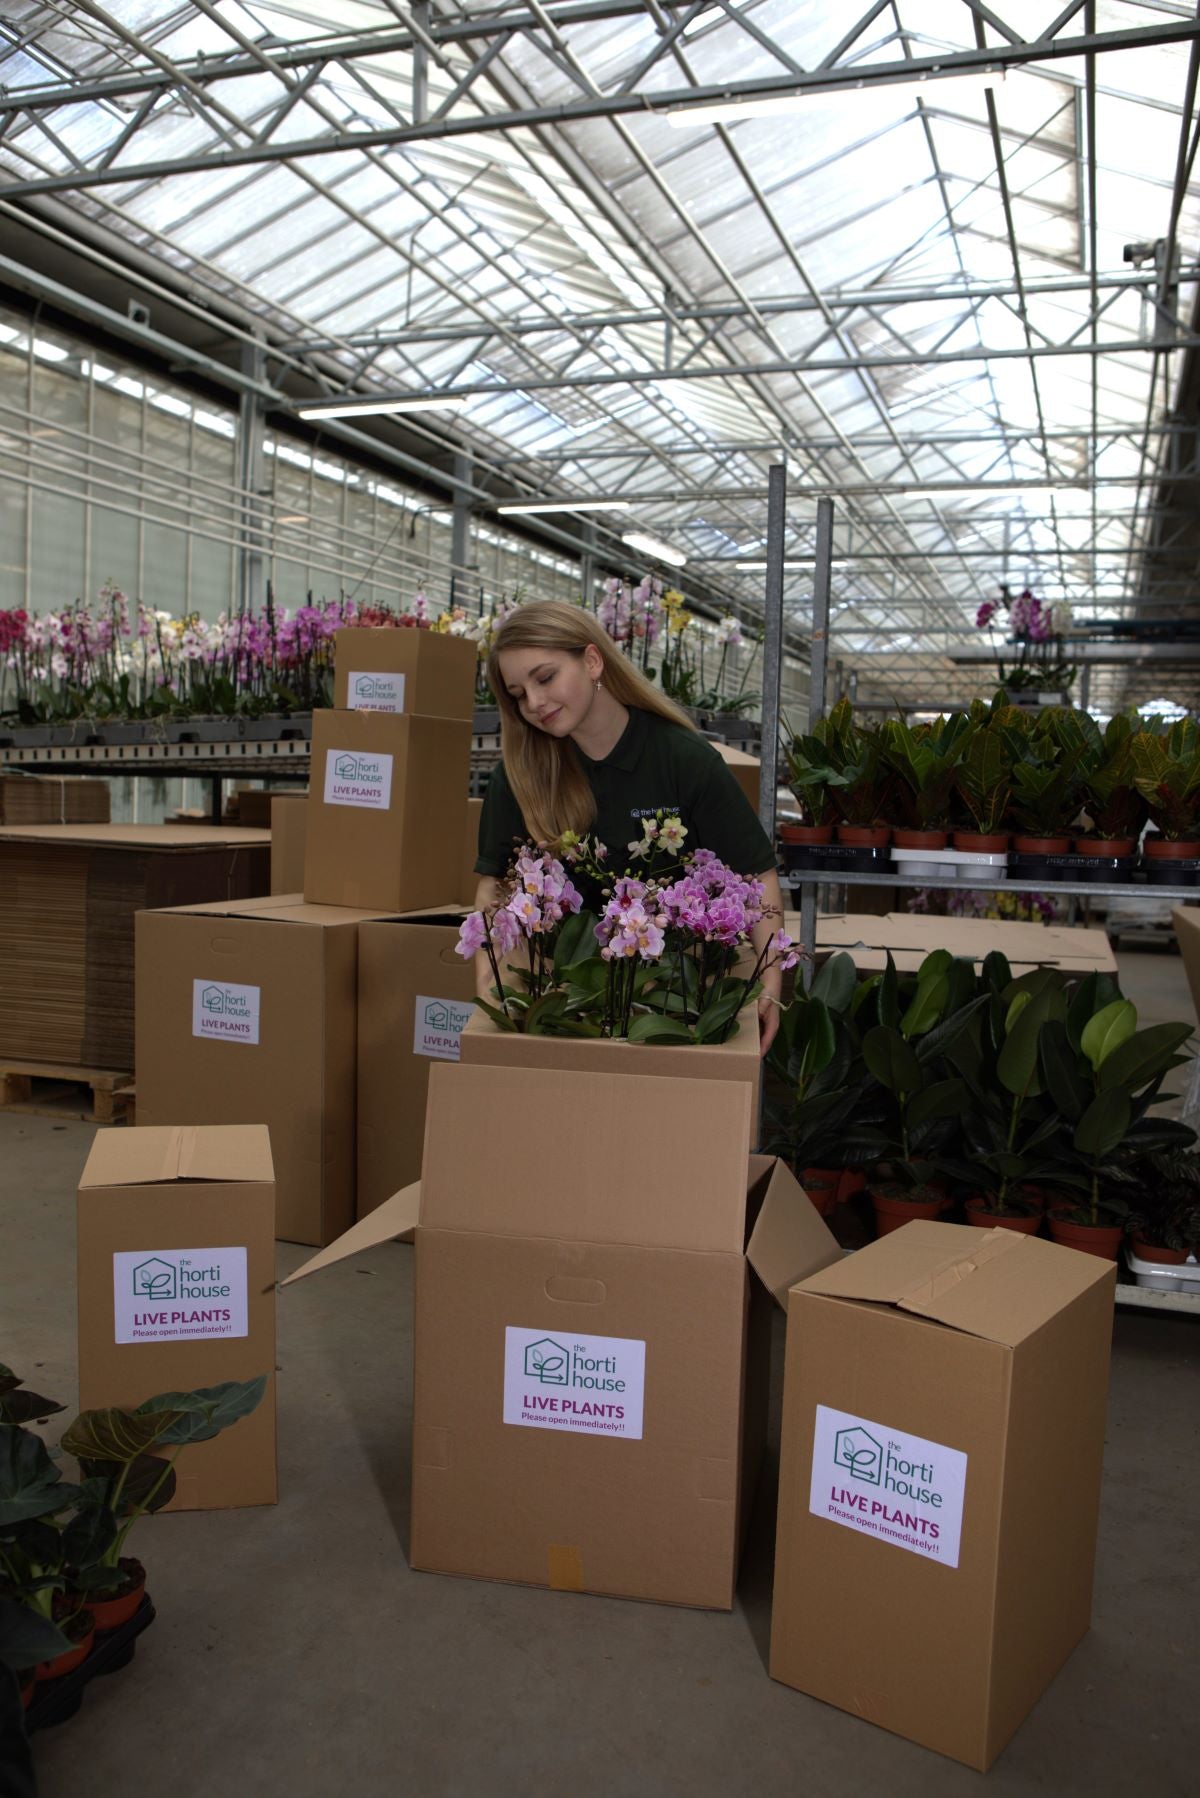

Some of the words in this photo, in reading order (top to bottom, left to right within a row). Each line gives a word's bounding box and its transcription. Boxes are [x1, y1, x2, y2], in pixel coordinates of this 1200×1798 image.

[358, 761, 379, 773] horti
[357, 771, 383, 783] house
[333, 785, 350, 795] LIVE
[351, 787, 382, 798] PLANTS
[225, 993, 246, 1006] horti
[224, 1005, 251, 1018] house
[201, 1019, 219, 1029] LIVE
[220, 1021, 250, 1033] PLANTS
[424, 1035, 442, 1046] LIVE
[443, 1038, 460, 1049] PLA
[179, 1258, 192, 1266] the
[180, 1265, 220, 1282] horti
[180, 1283, 231, 1299] house
[134, 1312, 168, 1326] LIVE
[171, 1309, 231, 1324] PLANTS
[132, 1329, 158, 1337] Please
[158, 1328, 178, 1337] open
[179, 1325, 232, 1335] immediately!!
[573, 1344, 587, 1353] the
[573, 1352, 616, 1374] horti
[572, 1370, 626, 1393] house
[523, 1395, 559, 1411] LIVE
[561, 1399, 625, 1419] PLANTS
[521, 1412, 548, 1422] Please
[548, 1415, 569, 1425] open
[569, 1417, 625, 1432] immediately!!
[887, 1440, 902, 1451] the
[886, 1449, 934, 1484] horti
[884, 1470, 943, 1508] house
[830, 1486, 868, 1513] LIVE
[871, 1501, 940, 1539] PLANTS
[828, 1504, 855, 1522] Please
[856, 1516, 878, 1530] open
[879, 1523, 940, 1554] immediately!!
